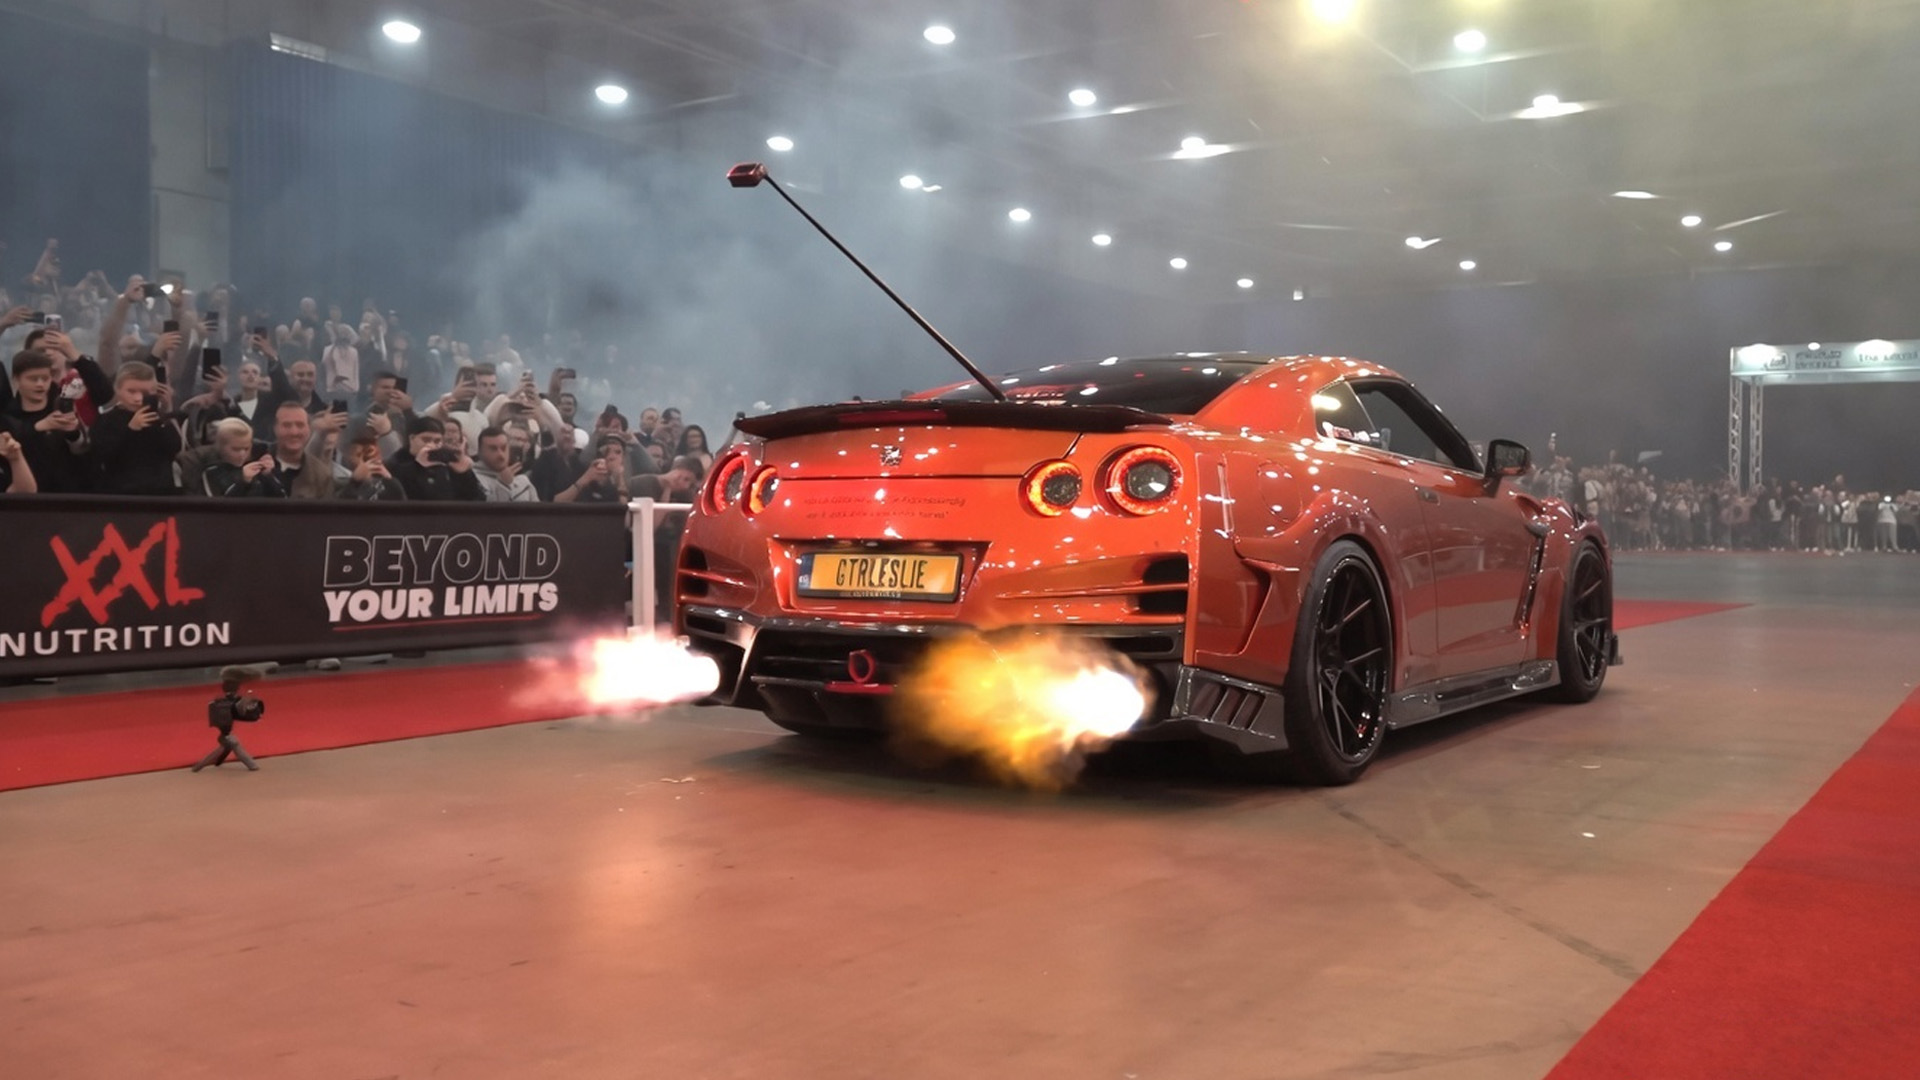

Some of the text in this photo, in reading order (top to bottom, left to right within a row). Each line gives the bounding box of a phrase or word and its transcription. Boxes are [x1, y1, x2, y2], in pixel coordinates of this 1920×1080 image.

[41, 517, 205, 628] XXL
[324, 533, 561, 587] BEYOND
[836, 558, 928, 589] GTRLESLIE
[323, 582, 559, 622] YOUR LIMITS
[0, 622, 230, 657] NUTRITION
